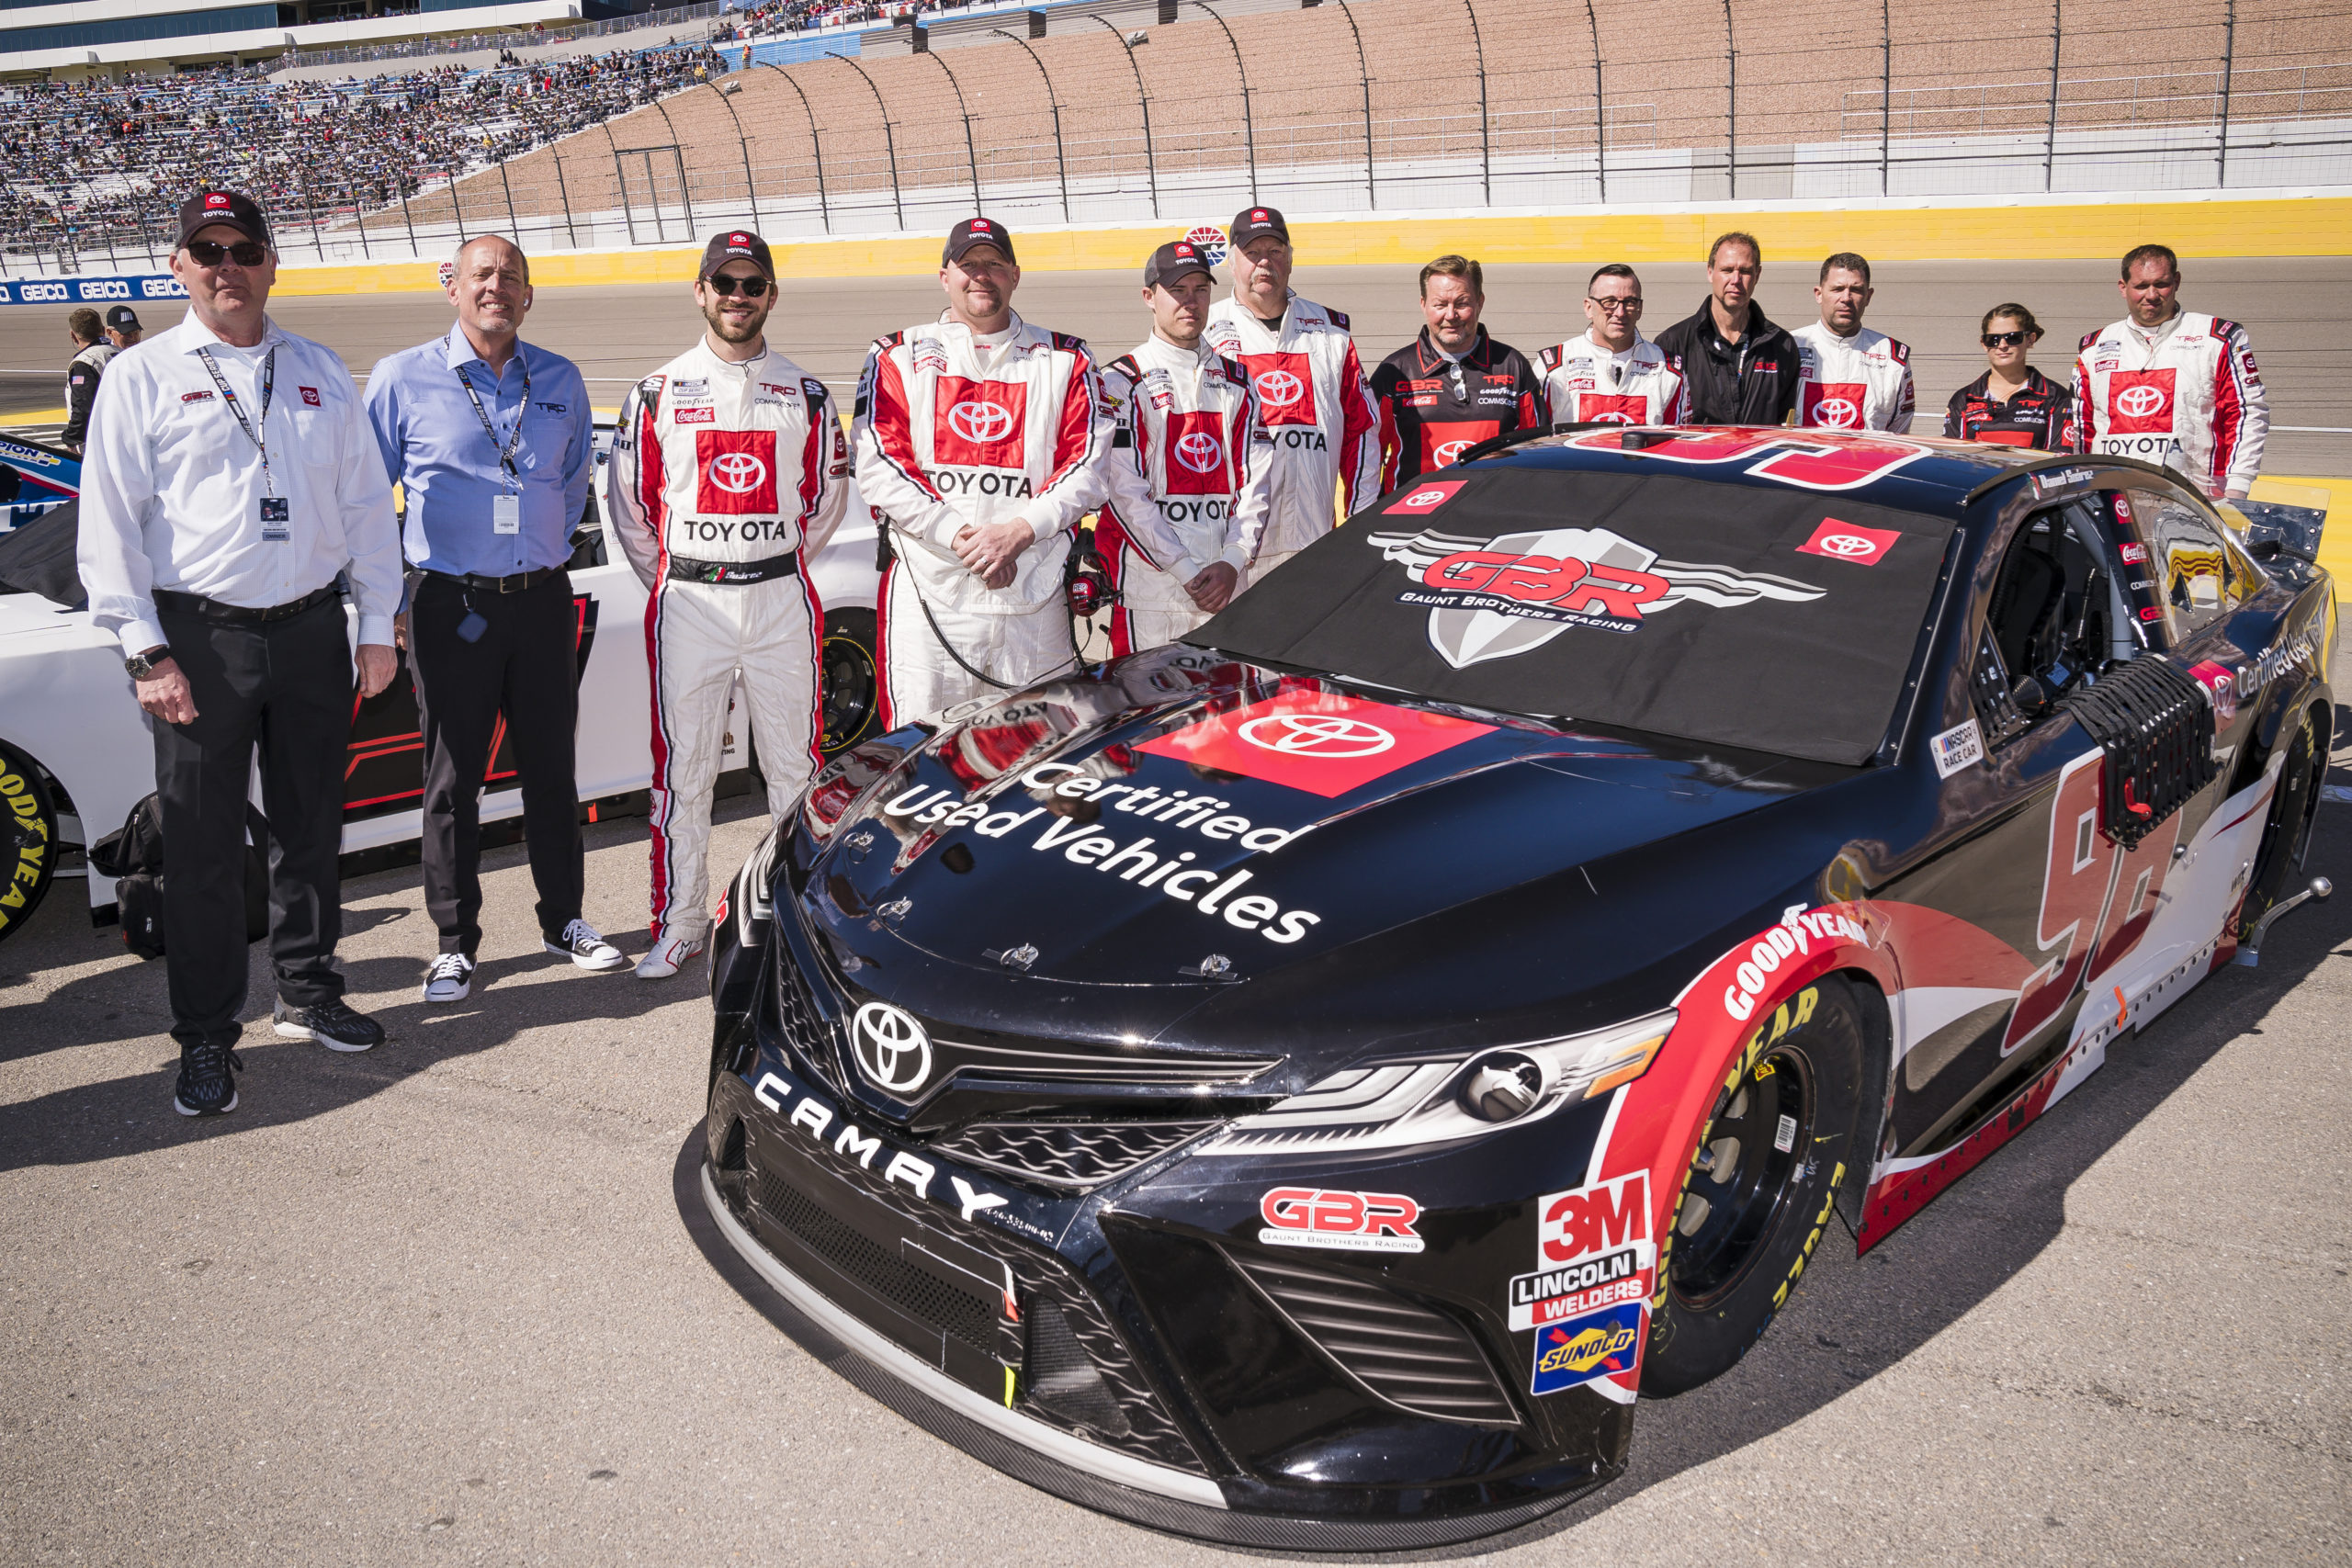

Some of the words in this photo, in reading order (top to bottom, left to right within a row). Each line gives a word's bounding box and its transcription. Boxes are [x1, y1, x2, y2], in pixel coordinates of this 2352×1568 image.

[201, 209, 235, 219] TOYOTA
[967, 232, 993, 241] TOYOTA
[726, 247, 752, 255] TOYOTA
[20, 283, 68, 301] GEICO
[79, 281, 130, 299] GEICO
[1295, 317, 1325, 327] TRD
[2176, 334, 2203, 343] TRD
[1862, 352, 1886, 360] TRD
[759, 382, 797, 396] TRD
[1396, 379, 1443, 392] GBR
[1483, 375, 1515, 386] TRD
[535, 402, 567, 414] TRD
[676, 408, 713, 423] Coca-Cola
[1271, 430, 1328, 452] YOTA
[2101, 437, 2183, 456] TOYOTA
[922, 469, 1033, 499] TOYOTA
[1155, 500, 1229, 522] TOYOT
[684, 521, 786, 542] TOYOTA
[1423, 550, 1670, 620] GBR
[1399, 592, 1459, 606] GAUNT
[1461, 595, 1556, 620] BROTHERS
[1562, 615, 1637, 633] RACING
[1943, 751, 1963, 770] RACE
[1962, 744, 1978, 760] CAR
[1021, 762, 1317, 853] Certified
[884, 784, 1046, 838] Used
[1032, 815, 1320, 944] Vehicles
[1724, 910, 1871, 1021] GOODYEAR
[753, 1072, 1009, 1222] CAMRY
[1261, 1186, 1421, 1238] GBR
[1542, 1175, 1647, 1262] 3M
[1262, 1232, 1301, 1242] GAUNT
[1307, 1235, 1369, 1247] BROTHERS
[1374, 1240, 1419, 1249] RACING
[1518, 1253, 1632, 1303] LINCOLN
[1544, 1279, 1643, 1320] WELDERS
[1541, 1329, 1633, 1372] SUNOCO
